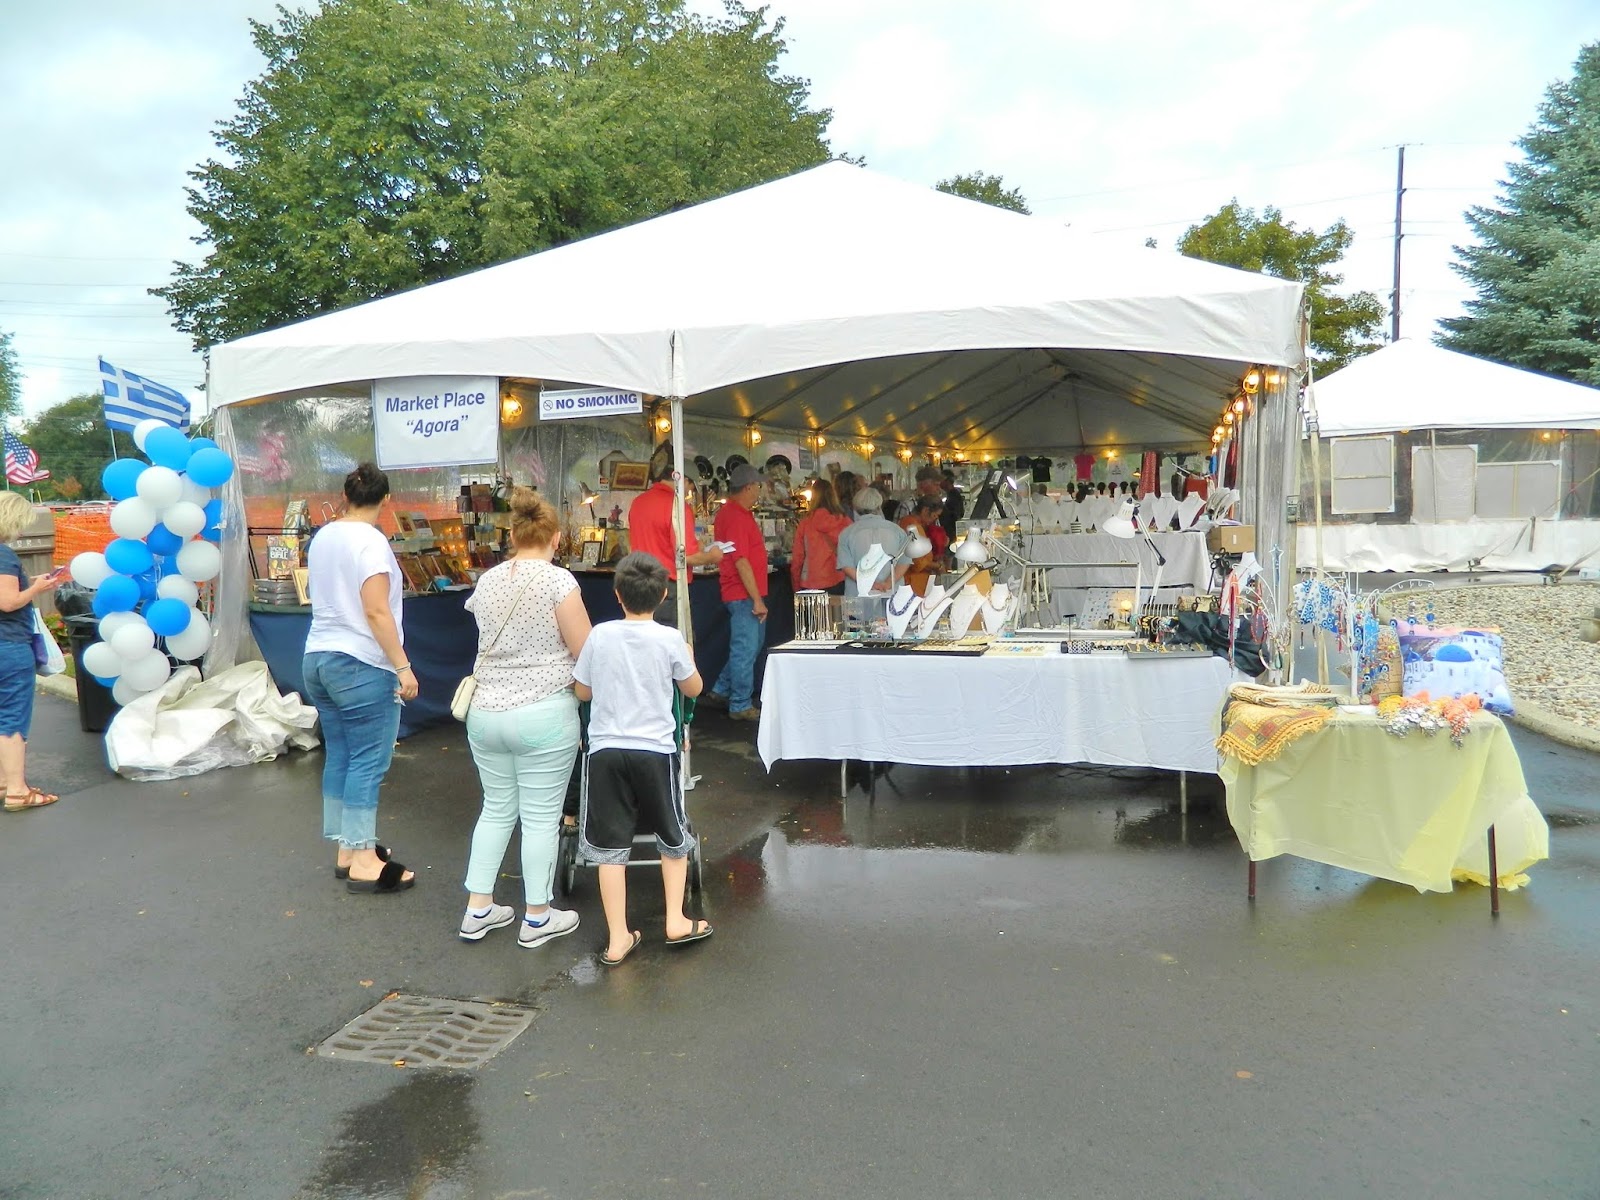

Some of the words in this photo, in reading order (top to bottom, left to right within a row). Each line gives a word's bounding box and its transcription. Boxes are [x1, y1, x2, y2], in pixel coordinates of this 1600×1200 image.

[386, 395, 439, 412] Market
[444, 392, 485, 408] Place
[556, 398, 574, 409] NO
[577, 393, 638, 408] SMOKING
[406, 414, 469, 437] “Agora”
